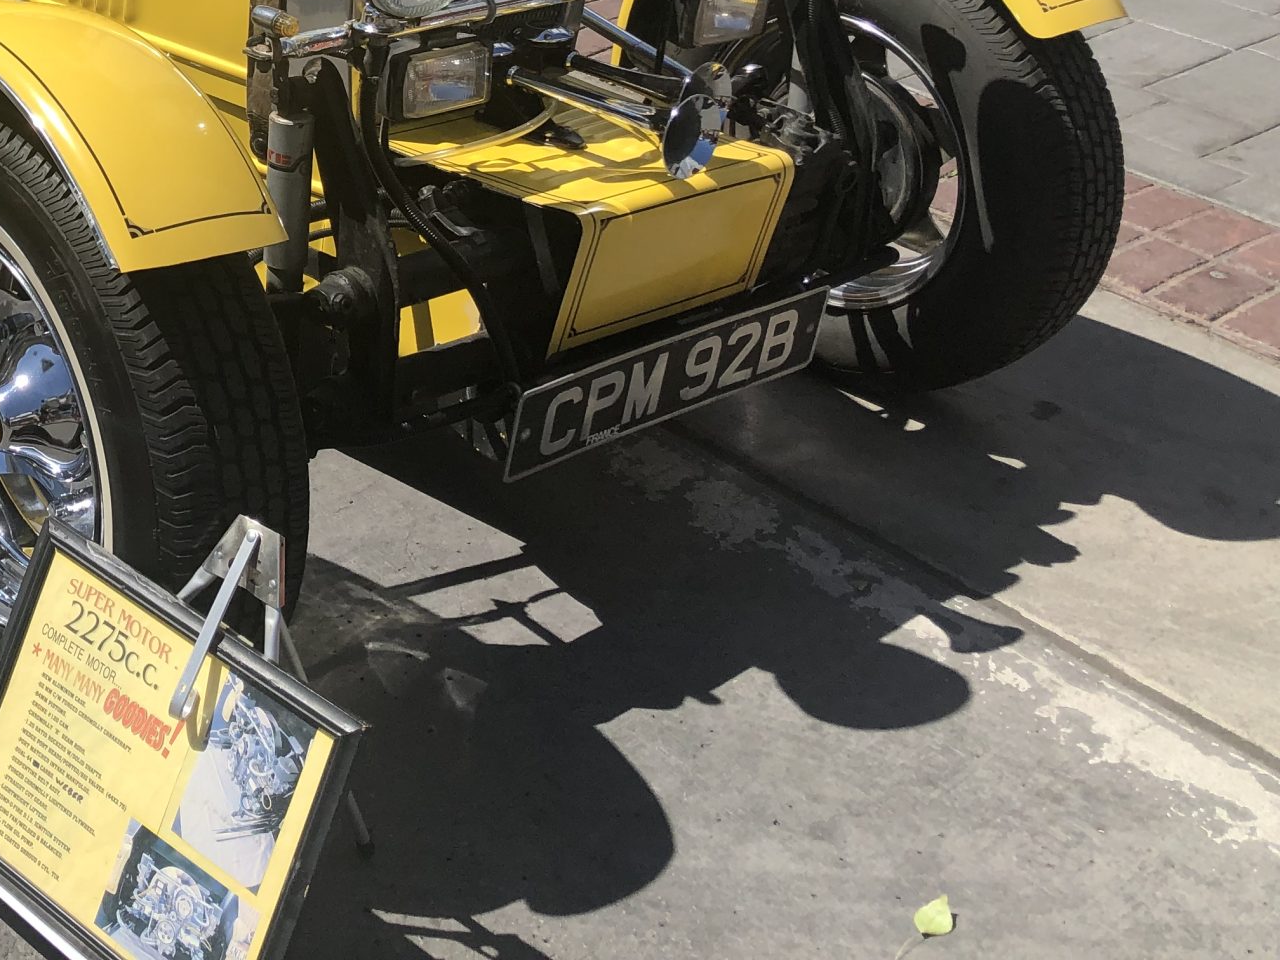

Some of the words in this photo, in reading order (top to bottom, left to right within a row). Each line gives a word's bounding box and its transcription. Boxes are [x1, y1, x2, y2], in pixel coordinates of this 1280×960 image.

[539, 351, 669, 456] CPM
[679, 309, 799, 401] 92B
[585, 423, 622, 447] FRANCE
[41, 621, 84, 661] COMPLETE
[67, 579, 114, 619] SUPER
[116, 608, 172, 664] MOTOR
[42, 647, 74, 683] MANY
[72, 669, 105, 706] MANY
[102, 687, 185, 760] GOODIES!
[54, 776, 83, 803] WEBER
